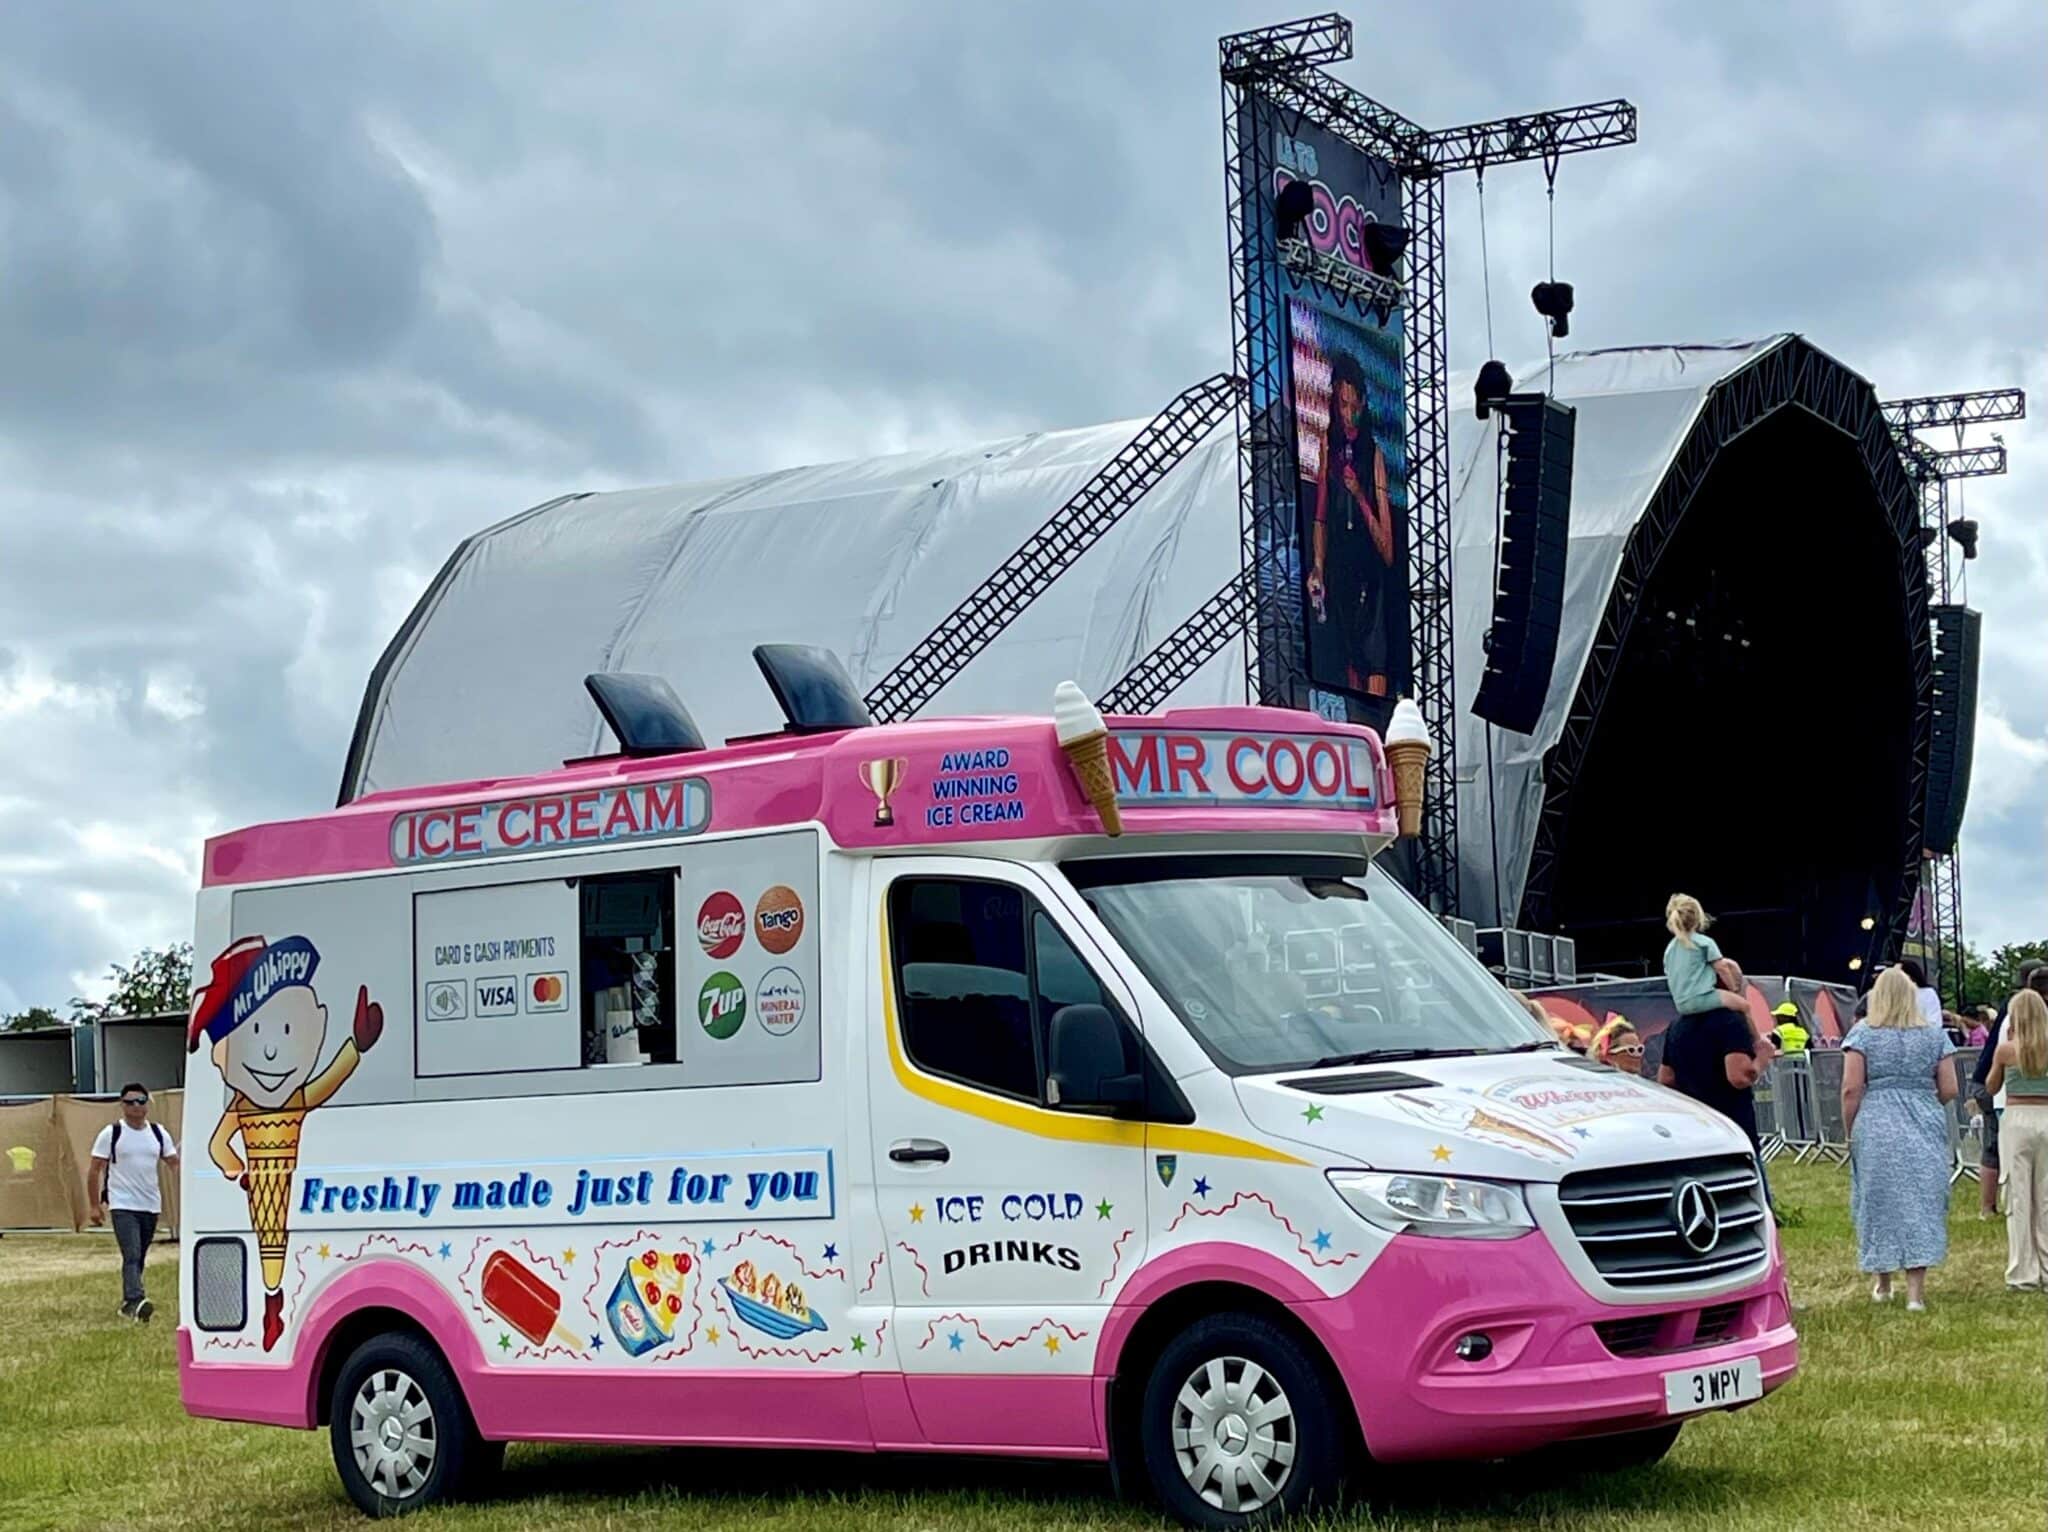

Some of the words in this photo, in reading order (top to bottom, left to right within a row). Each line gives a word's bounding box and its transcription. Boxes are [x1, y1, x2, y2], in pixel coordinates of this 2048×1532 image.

[941, 748, 1009, 772] AWARD
[1105, 735, 1212, 793] MR
[1226, 736, 1370, 797] COOL
[932, 774, 1018, 800] WINNING
[406, 807, 486, 859] ICE
[497, 783, 692, 846] CREAM
[926, 806, 953, 826] ICE
[960, 801, 1024, 824] CREAM
[760, 908, 799, 931] Tango
[435, 945, 461, 966] CARD
[474, 941, 501, 963] CASH
[503, 936, 555, 960] PAYMENTS
[233, 990, 253, 1024] Mr
[253, 950, 311, 1002] Whippy
[478, 986, 516, 1007] VISA
[760, 1000, 800, 1012] MINERAL
[765, 1013, 795, 1025] WATER
[300, 1176, 441, 1218] Freshly
[452, 1172, 553, 1210] made
[567, 1168, 654, 1216] just
[668, 1166, 732, 1204] for
[745, 1170, 819, 1210] you
[936, 1196, 985, 1223] ICE
[1001, 1193, 1083, 1222] COLD
[943, 1240, 1081, 1274] DRINKS
[1692, 1374, 1705, 1404] 3
[1709, 1367, 1740, 1402] WPY
